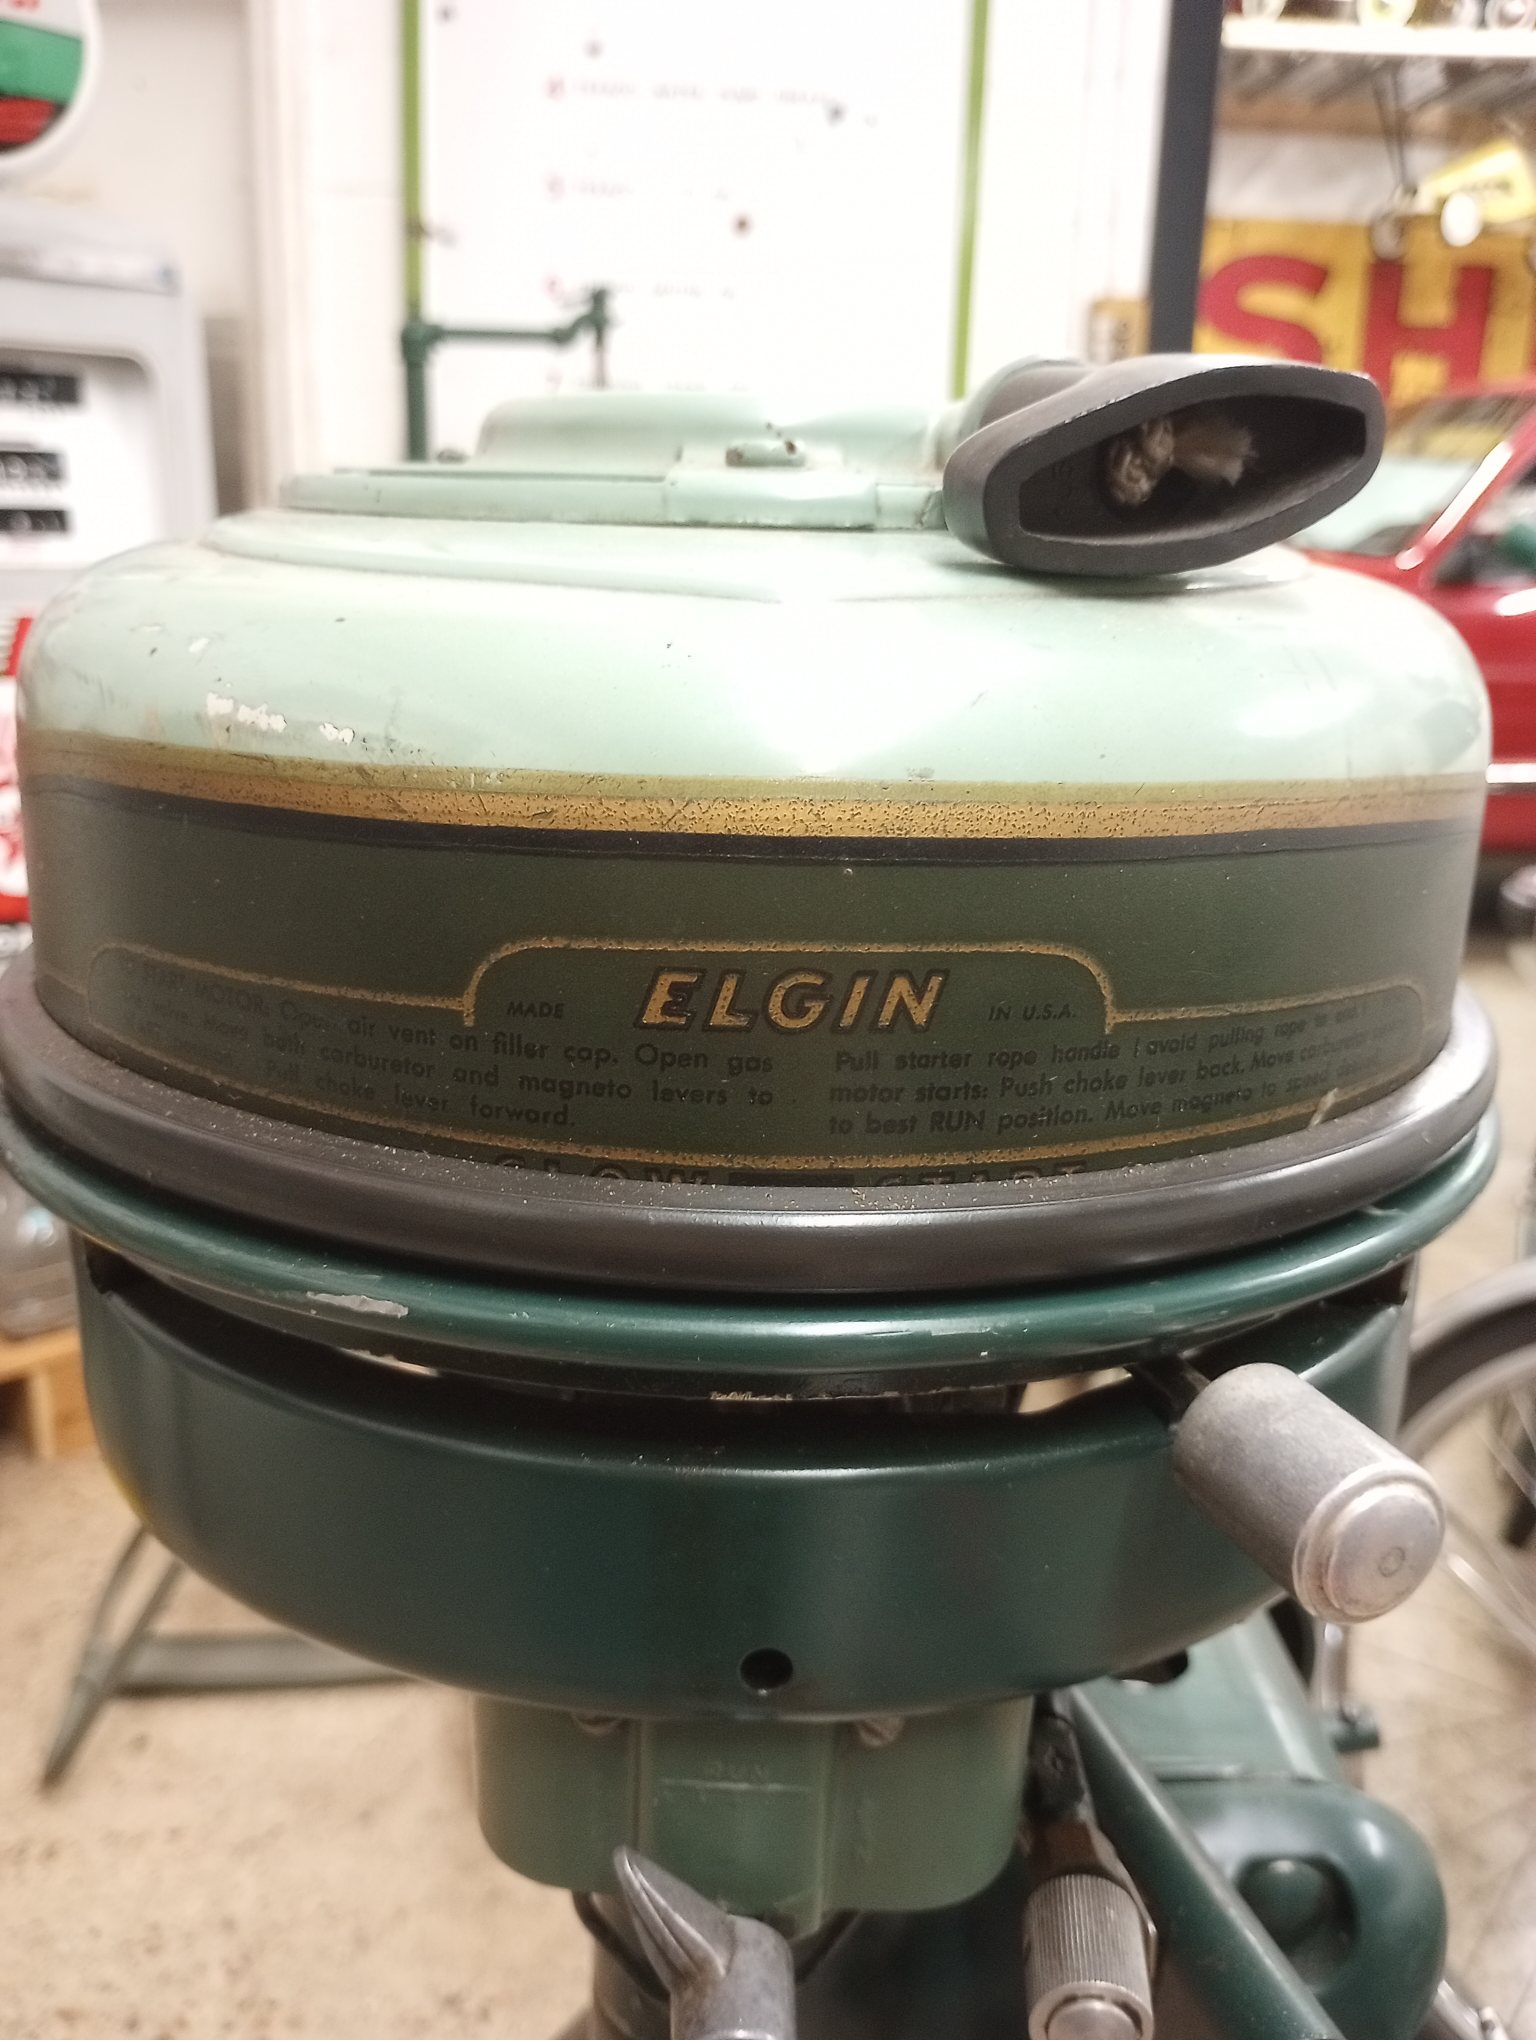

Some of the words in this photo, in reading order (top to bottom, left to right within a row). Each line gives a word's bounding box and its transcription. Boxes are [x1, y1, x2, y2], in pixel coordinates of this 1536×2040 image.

[1197, 254, 1536, 402] SH
[506, 1000, 566, 1020] MADE
[633, 964, 951, 1035] ELGIN
[988, 1004, 1012, 1021] IN
[1022, 1002, 1077, 1021] U.S.A.
[346, 1015, 376, 1039] air
[388, 1023, 436, 1047] vent
[449, 1033, 478, 1051] on
[493, 1031, 550, 1060] filler
[634, 1043, 708, 1072] Open
[727, 1056, 774, 1077] gas
[835, 1050, 879, 1072] Pull
[895, 1051, 972, 1070] starter
[988, 1049, 1038, 1071] rope
[1052, 1039, 1121, 1064] handle
[1207, 1026, 1265, 1053] pulling
[315, 1070, 376, 1101] choke
[394, 1083, 449, 1112] lever
[469, 1093, 576, 1127] forward.
[320, 1044, 435, 1078] carburetor
[452, 1064, 499, 1087] and
[518, 1074, 632, 1100] magneto
[652, 1079, 728, 1105] levers
[748, 1087, 774, 1105] to
[829, 1083, 904, 1103] motor
[1001, 1072, 1053, 1098] Push
[1063, 1069, 1128, 1094] choke
[1137, 1065, 1187, 1088] lever
[1249, 1049, 1295, 1073] Move
[828, 1114, 854, 1135] to
[865, 1110, 918, 1134] best
[930, 1108, 986, 1134] RUN
[997, 1103, 1093, 1136] position.
[1104, 1099, 1163, 1122] Move
[1172, 1085, 1254, 1115] magneto
